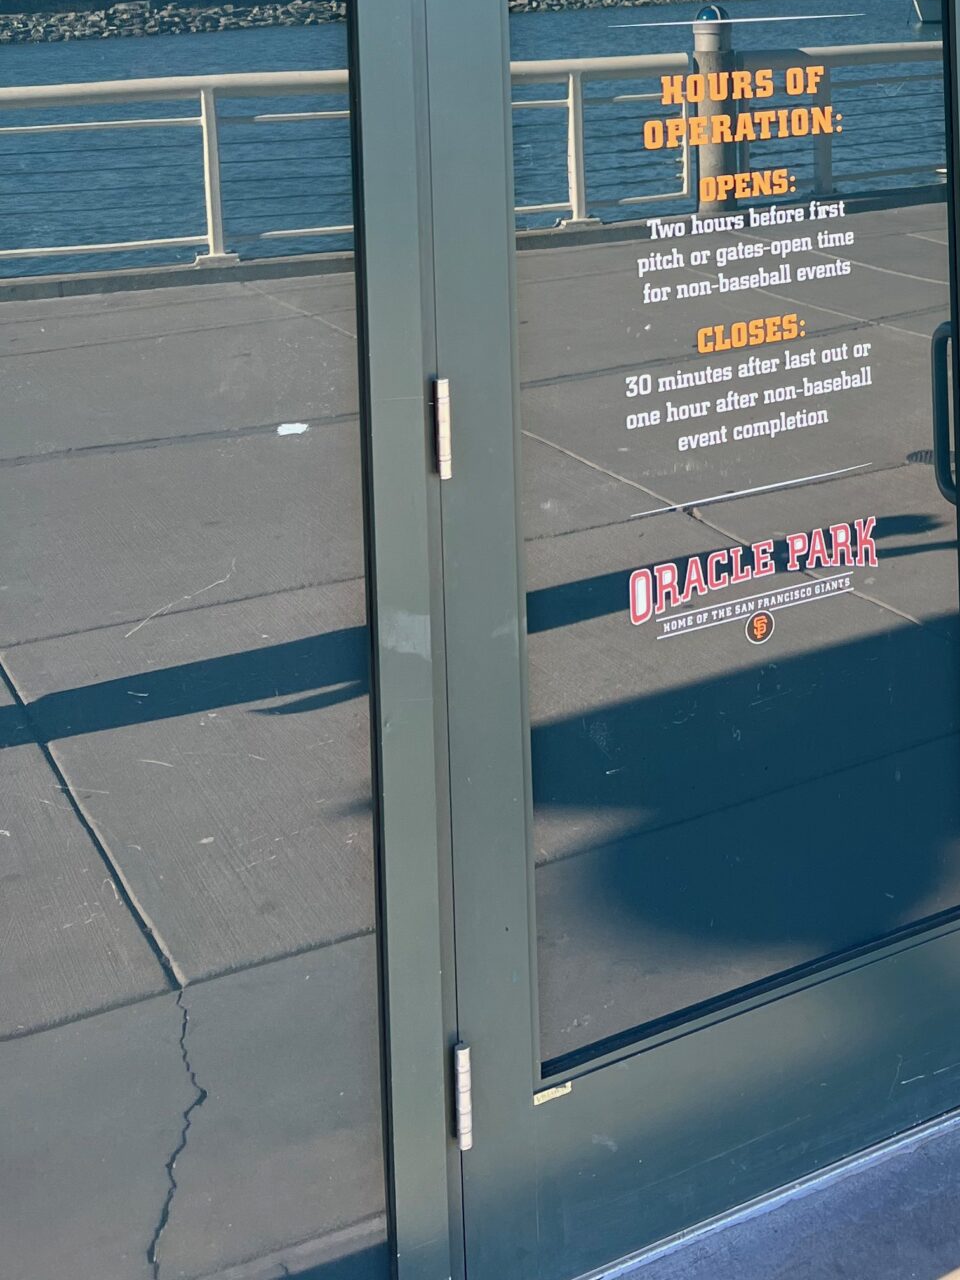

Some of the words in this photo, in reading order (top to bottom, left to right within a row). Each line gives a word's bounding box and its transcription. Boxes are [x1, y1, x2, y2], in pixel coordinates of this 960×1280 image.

[661, 69, 773, 105] HOURS
[786, 66, 825, 95] OF
[643, 106, 843, 150] OPERATION:
[699, 169, 796, 202] OPENS:
[647, 218, 686, 240] Two
[691, 214, 744, 235] hours
[749, 208, 804, 228] before
[809, 200, 846, 221] first
[637, 248, 684, 277] pitch
[690, 249, 710, 265] or
[716, 235, 812, 267] gates-open
[817, 230, 854, 249] time
[643, 283, 671, 304] for
[676, 264, 792, 299] non-baseball
[796, 259, 851, 281] events
[697, 314, 806, 353] CLOSES:
[625, 374, 652, 397] 30
[658, 363, 732, 393] minutes
[738, 356, 780, 378] after
[784, 348, 816, 370] last
[821, 343, 848, 364] out
[853, 341, 872, 358] or
[626, 408, 660, 430] one
[667, 401, 711, 424] hour
[716, 390, 758, 413] after
[763, 366, 872, 405] non-baseball
[678, 426, 727, 451] event
[733, 409, 829, 440] completion
[629, 539, 776, 625] ORACLE
[786, 516, 878, 571] PARK
[663, 616, 693, 632] HOME
[696, 613, 709, 624] OF
[712, 607, 732, 620] THE
[735, 601, 755, 614] SAN
[758, 587, 812, 609] FRANCISCO
[814, 578, 850, 594] GIANTS
